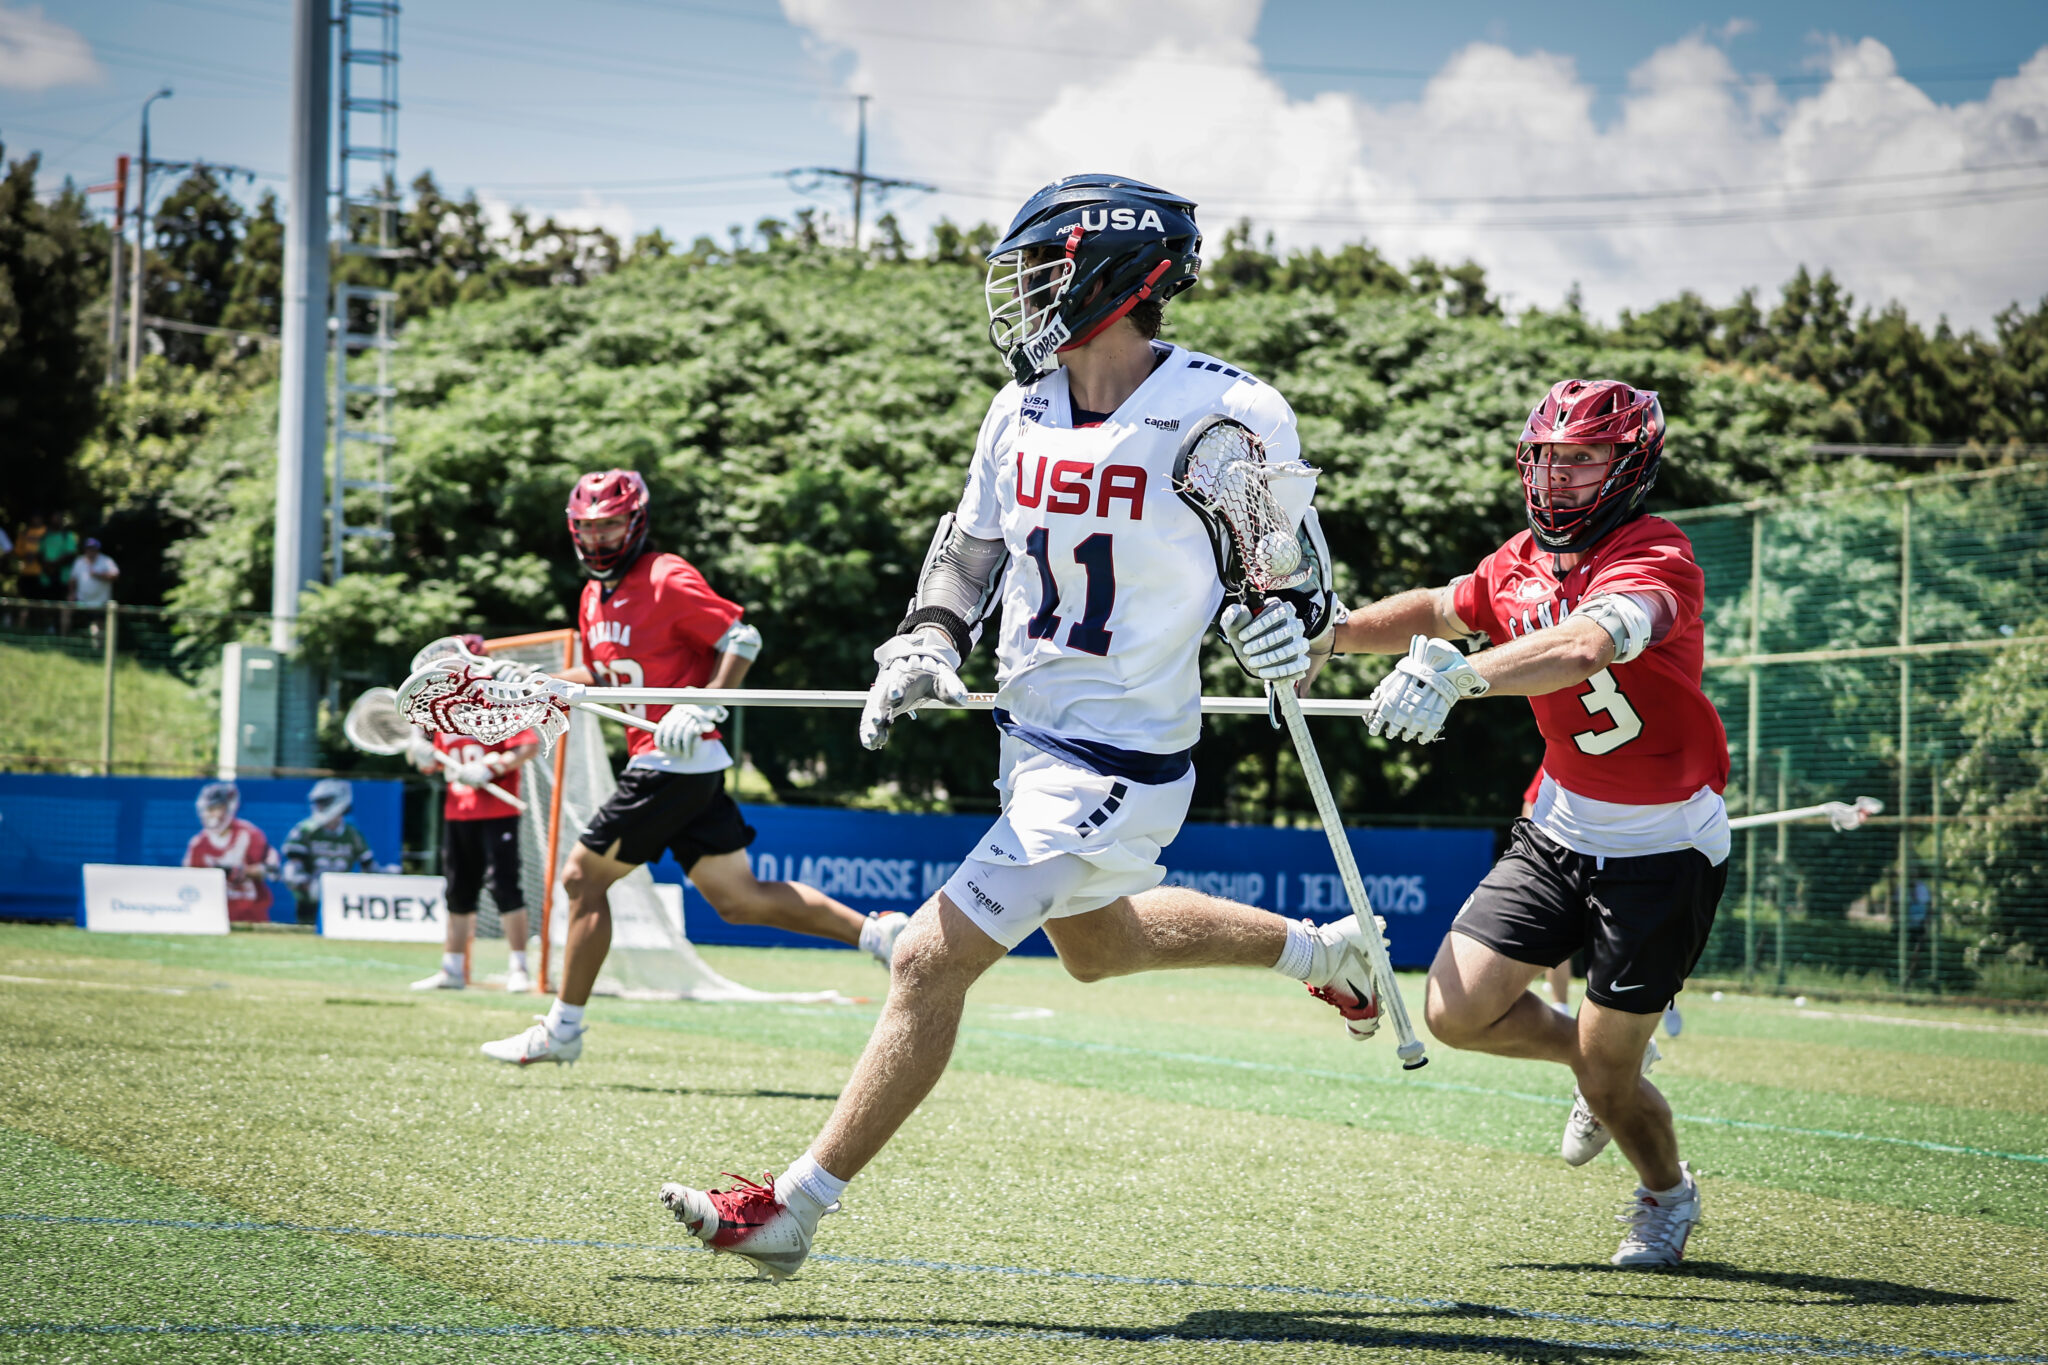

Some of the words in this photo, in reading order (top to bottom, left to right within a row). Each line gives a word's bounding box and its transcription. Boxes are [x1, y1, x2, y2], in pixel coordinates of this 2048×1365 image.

[1081, 207, 1166, 233] USA
[1024, 396, 1049, 407] USA
[1144, 417, 1180, 430] capelli
[1016, 451, 1148, 521] USA
[1026, 525, 1116, 658] 11
[1508, 594, 1582, 640] CANA
[1571, 665, 1645, 756] 3
[782, 855, 915, 899] LACROSSE
[342, 893, 438, 922] HDEX
[967, 880, 1005, 915] capelli
